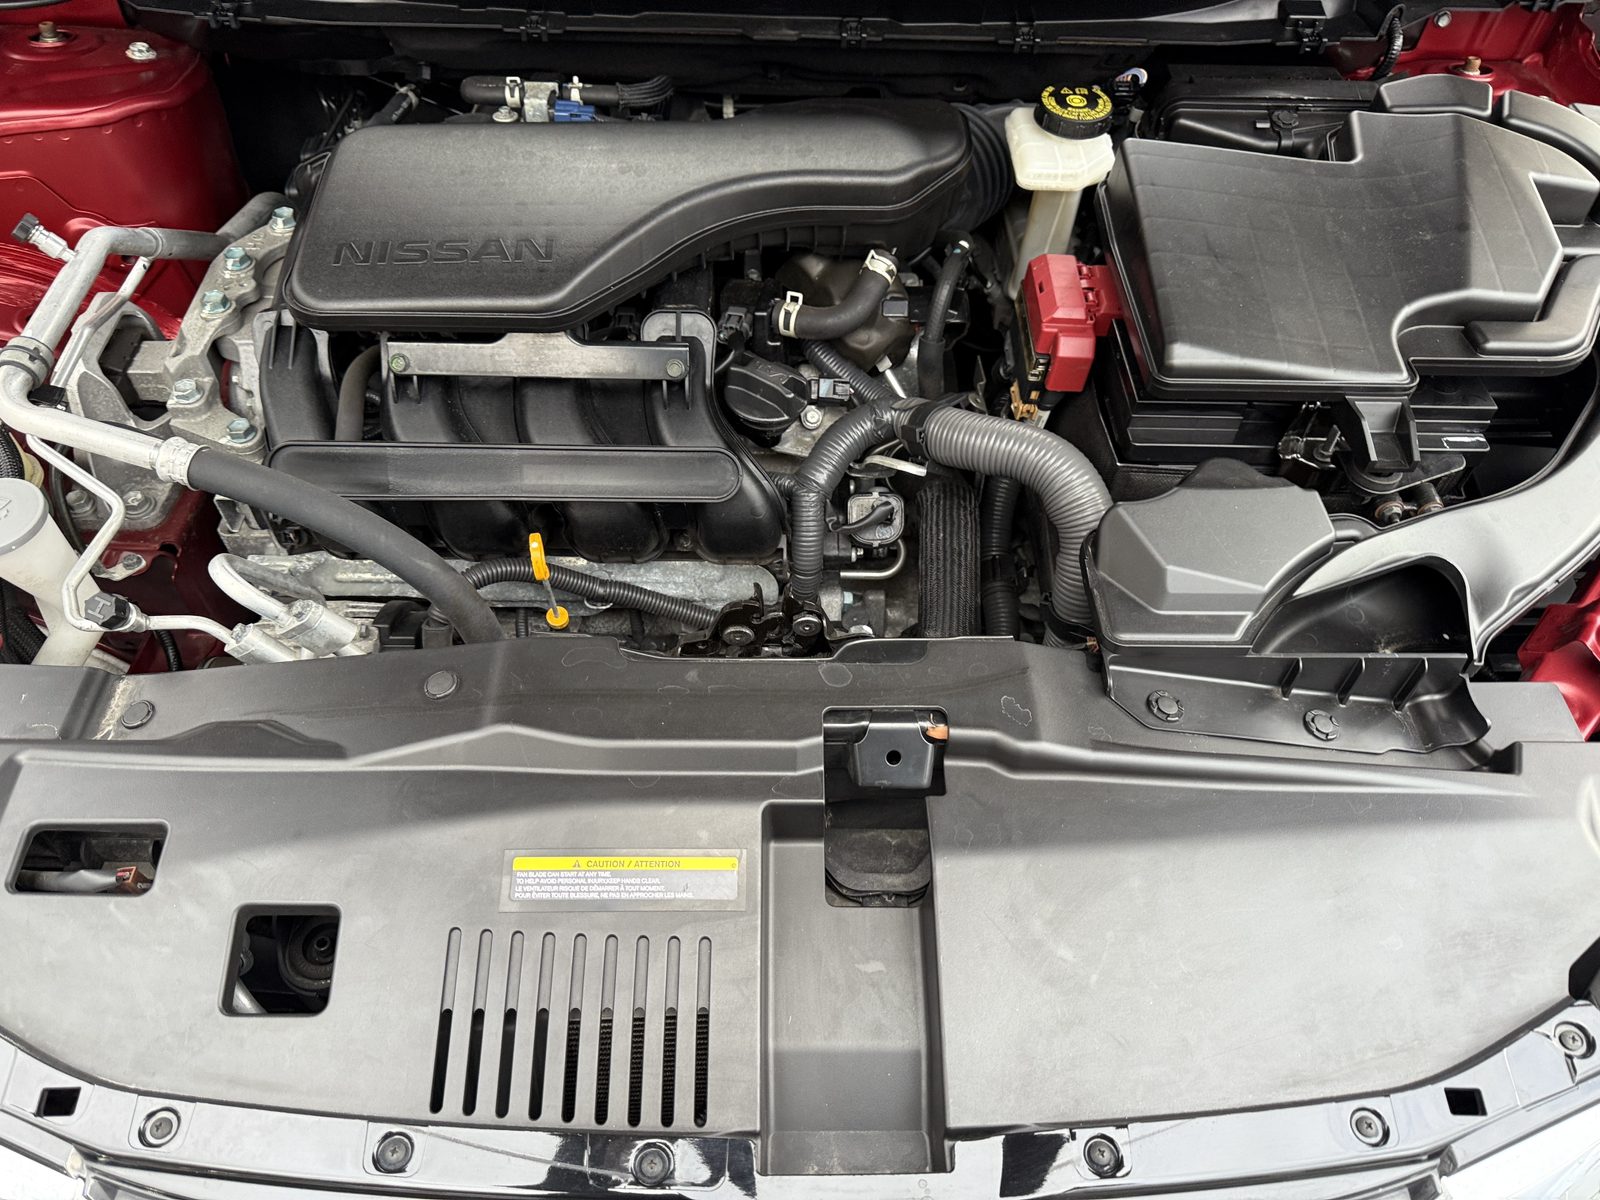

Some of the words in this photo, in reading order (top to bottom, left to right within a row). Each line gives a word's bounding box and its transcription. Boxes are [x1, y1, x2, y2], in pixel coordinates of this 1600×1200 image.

[332, 239, 554, 266] NISSAN
[87, 596, 111, 619] H
[586, 860, 625, 868] CAUTION
[634, 860, 681, 868] ATTENTION
